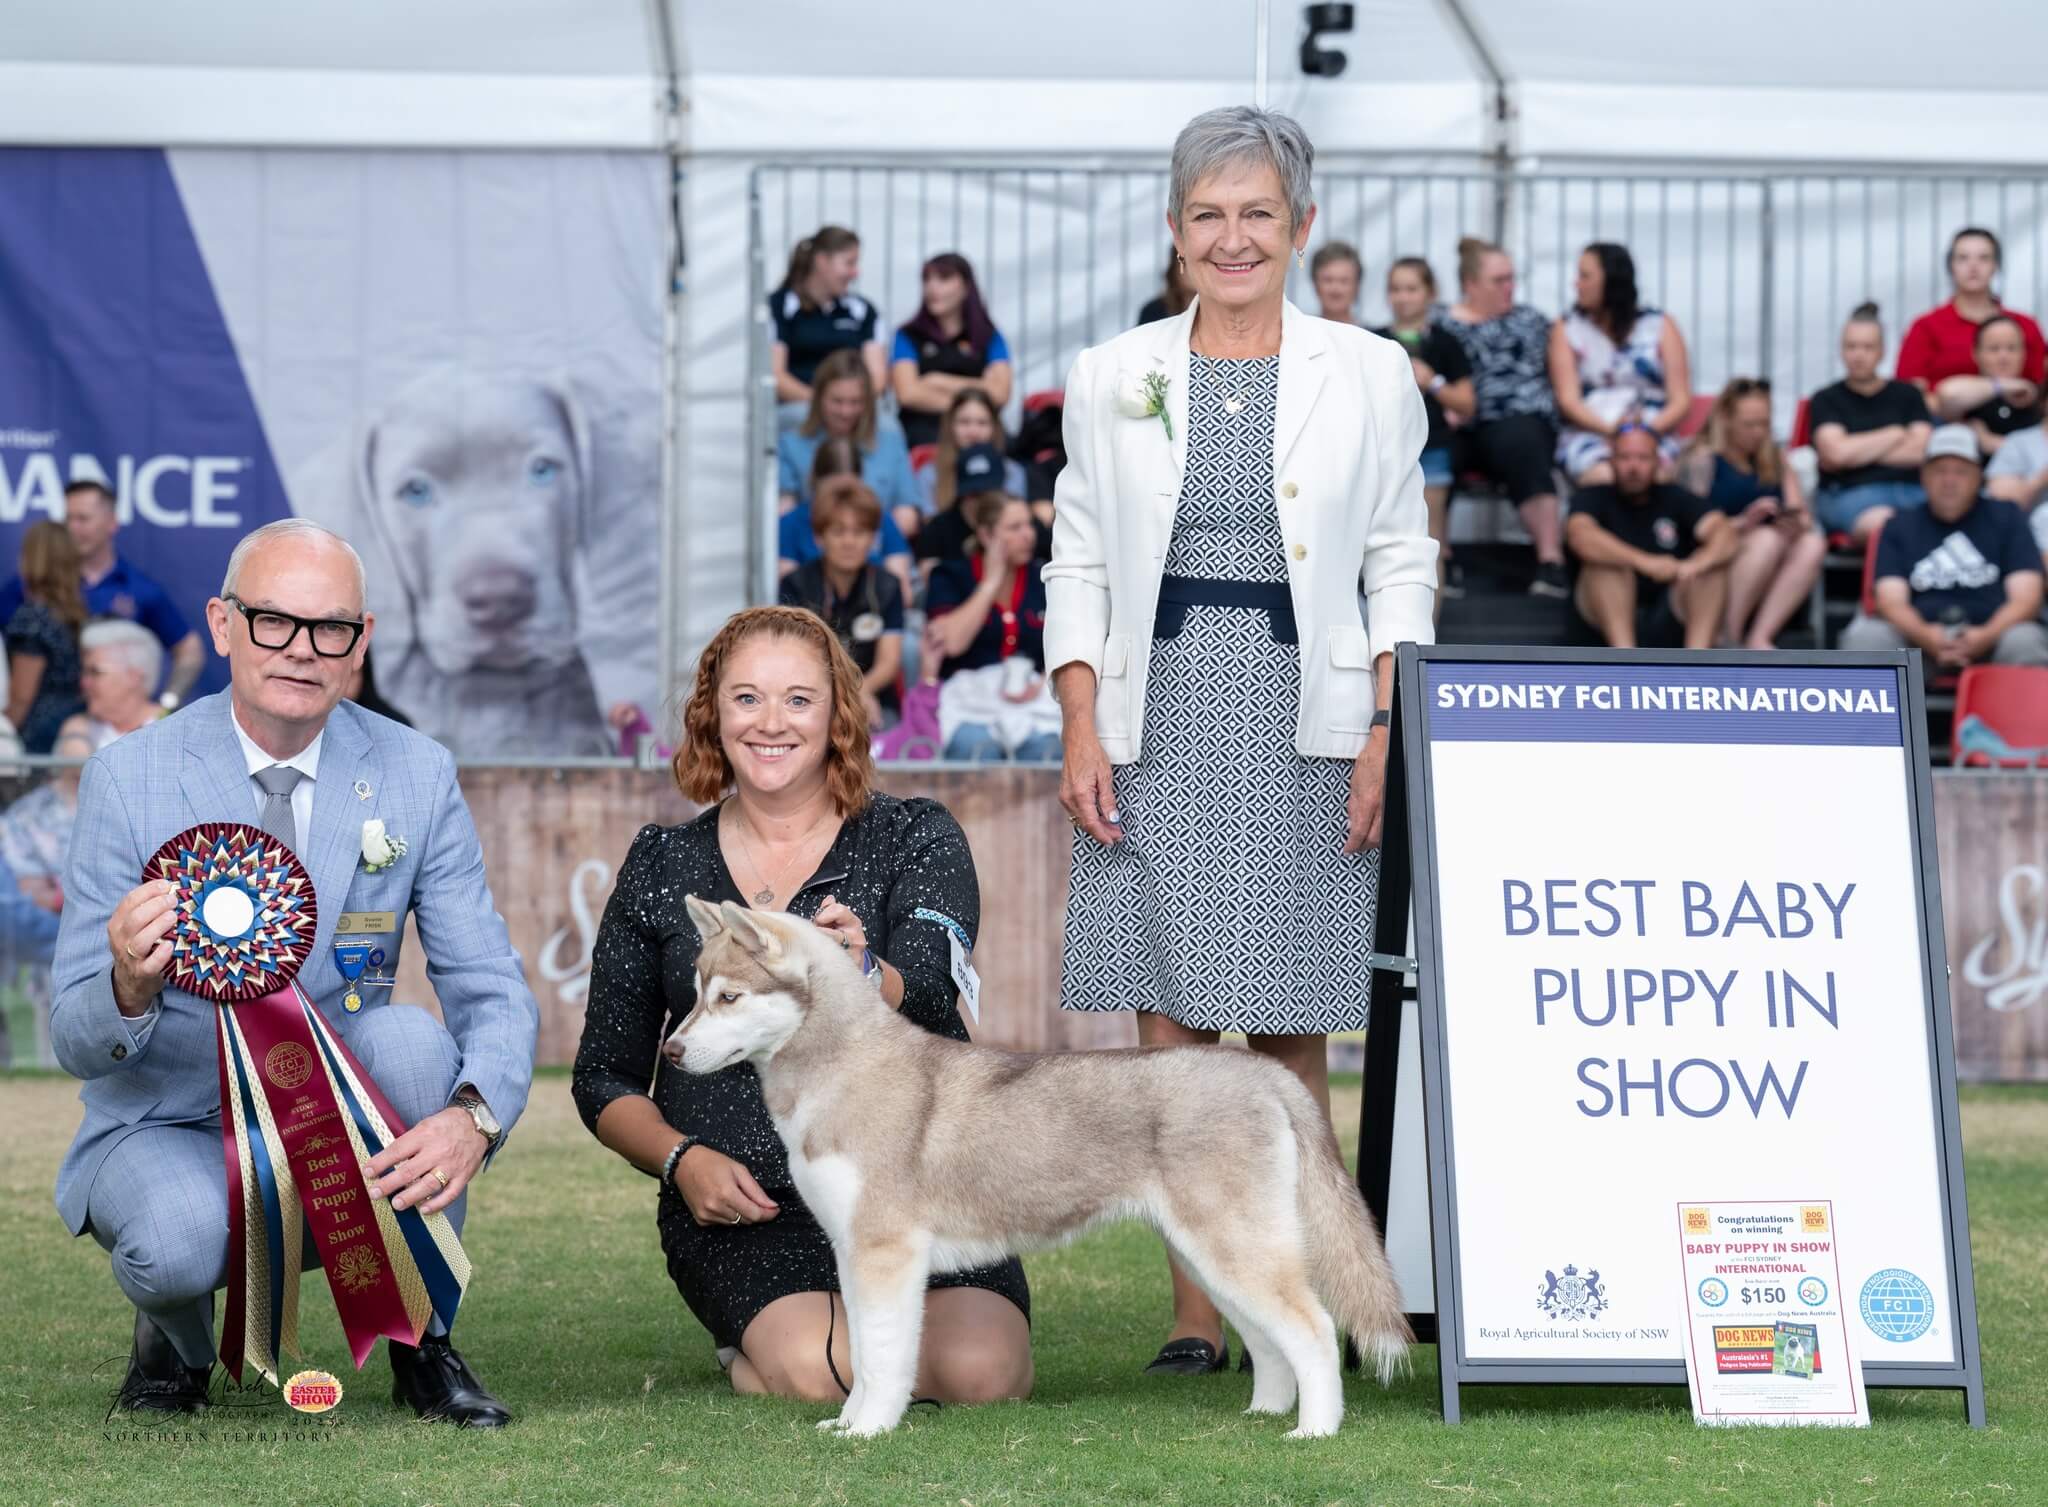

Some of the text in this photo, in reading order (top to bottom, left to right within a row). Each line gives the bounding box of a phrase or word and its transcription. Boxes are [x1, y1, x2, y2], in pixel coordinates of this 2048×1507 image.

[1437, 684, 1896, 713] SYDNEY FCI INTERNATIONAL
[1502, 879, 1857, 940] BEST BABY
[1533, 968, 1839, 1030] PUPPY IN
[1576, 1057, 1809, 1120] SHOW
[290, 1100, 319, 1115] SYDNEY
[282, 1111, 340, 1136] INTERNATIONAL
[306, 1152, 339, 1173] Best
[311, 1171, 347, 1191] Baby
[312, 1187, 357, 1211] Puppy
[332, 1210, 350, 1224] In
[1717, 1215, 1795, 1226] Congratulations
[328, 1224, 365, 1245] Show
[1745, 1225, 1783, 1235] winning
[1686, 1242, 1830, 1255] BABY PUPPY IN SHOW
[1715, 1263, 1807, 1274] INTERNATIONAL
[1740, 1286, 1787, 1306] $150
[1883, 1300, 1911, 1312] FCI
[1479, 1327, 1669, 1341] Royal Agricultural Society of NSW
[1716, 1329, 1774, 1342] DOG NEWS
